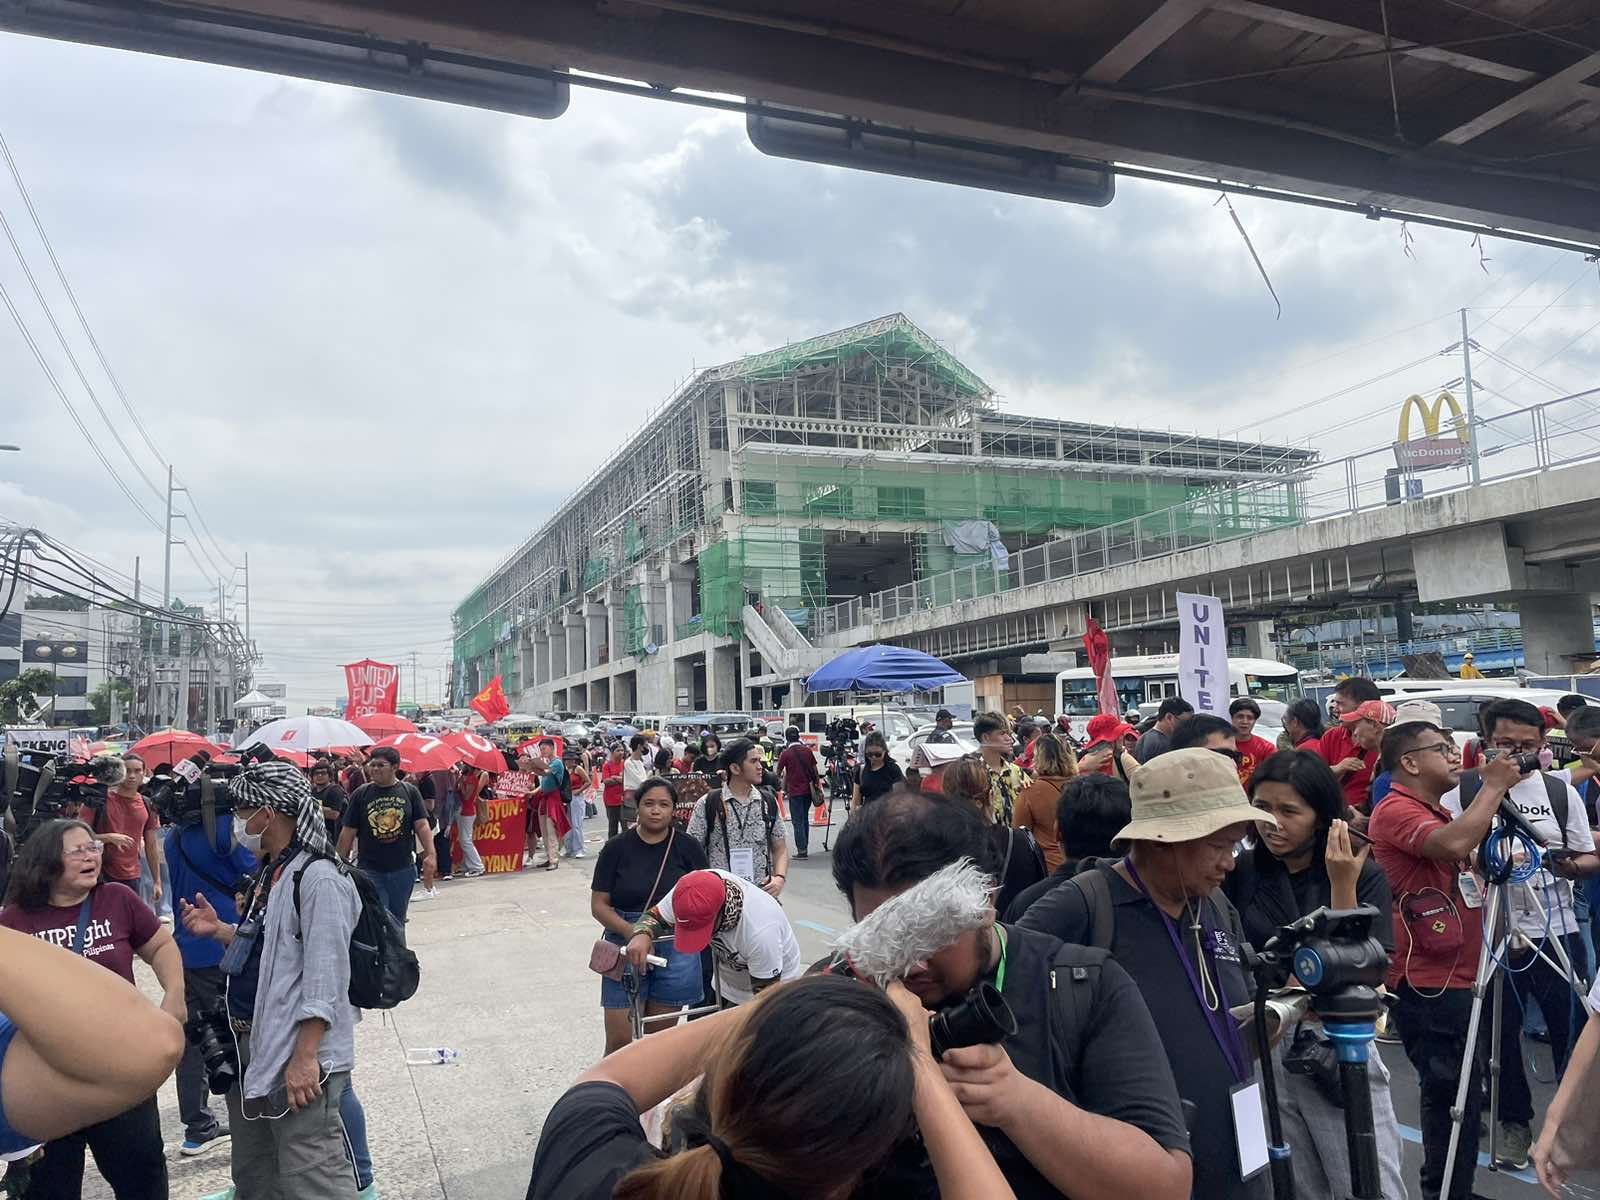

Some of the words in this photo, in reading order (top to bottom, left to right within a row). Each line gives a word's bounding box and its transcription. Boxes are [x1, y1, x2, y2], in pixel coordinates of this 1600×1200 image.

[1192, 603, 1213, 710] UNITE
[1520, 804, 1550, 815] bok
[473, 822, 506, 840] COS,
[483, 853, 519, 872] YAN!
[32, 919, 112, 948] UPFght
